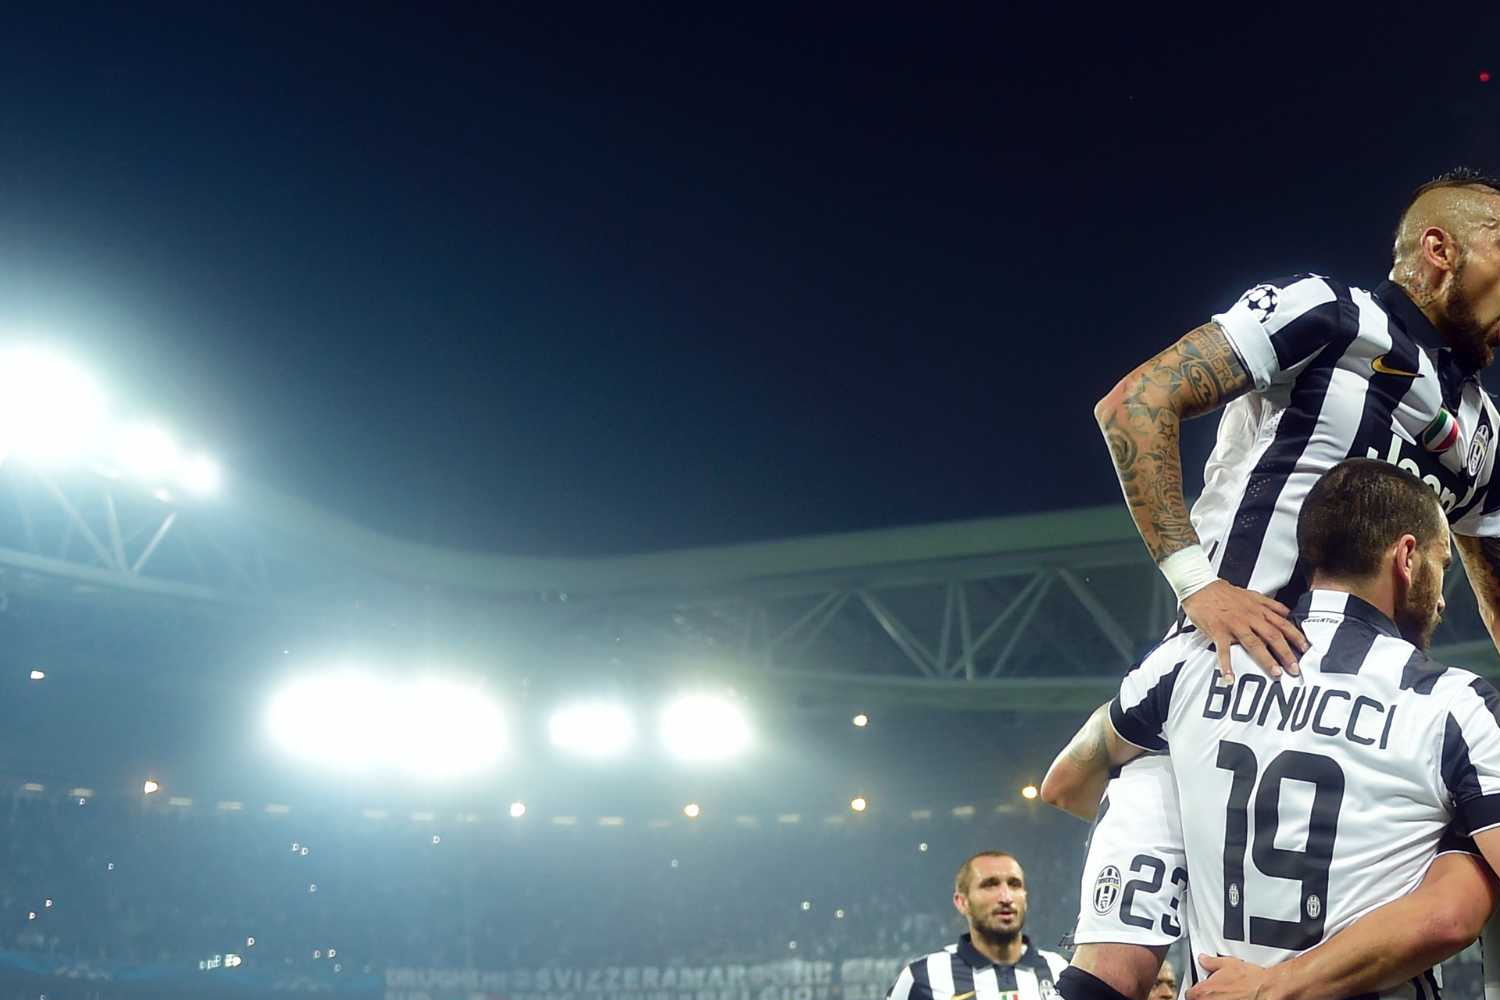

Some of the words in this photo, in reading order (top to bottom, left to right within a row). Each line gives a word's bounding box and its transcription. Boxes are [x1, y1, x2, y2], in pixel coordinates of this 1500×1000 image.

[1203, 669, 1397, 749] BONUCCI
[1216, 740, 1345, 950] 19
[1120, 854, 1188, 937] 23
